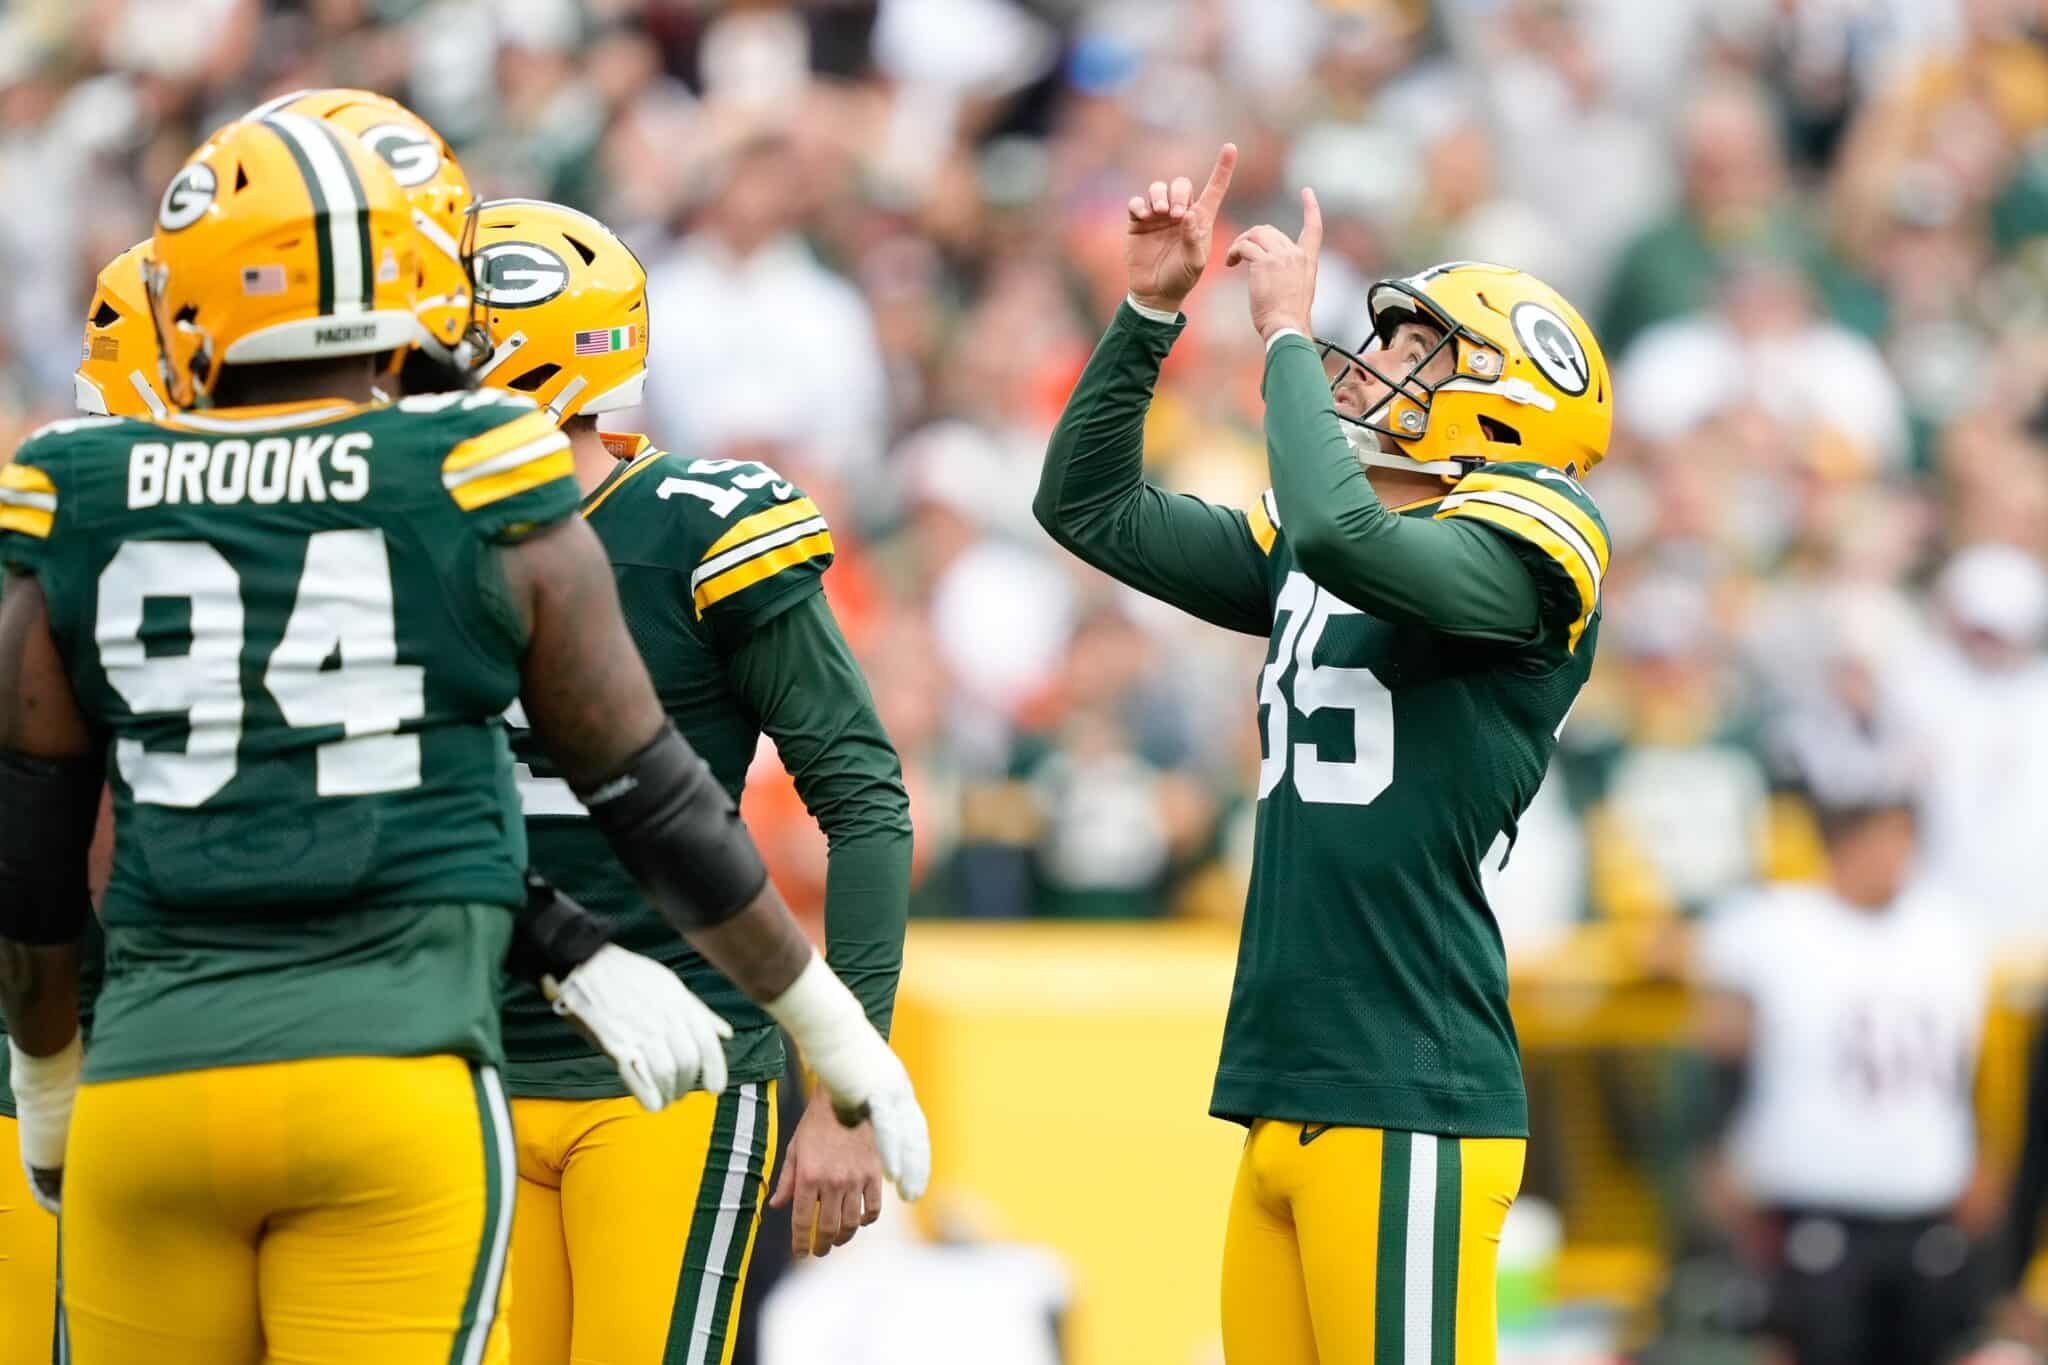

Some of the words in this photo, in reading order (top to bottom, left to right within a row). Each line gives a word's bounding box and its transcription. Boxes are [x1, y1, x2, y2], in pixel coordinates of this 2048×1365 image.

[159, 162, 215, 231] G
[472, 244, 565, 304] G
[1515, 304, 1588, 393] G
[127, 432, 373, 510] BROOKS
[95, 528, 425, 808] 94
[1257, 571, 1394, 805] 35
